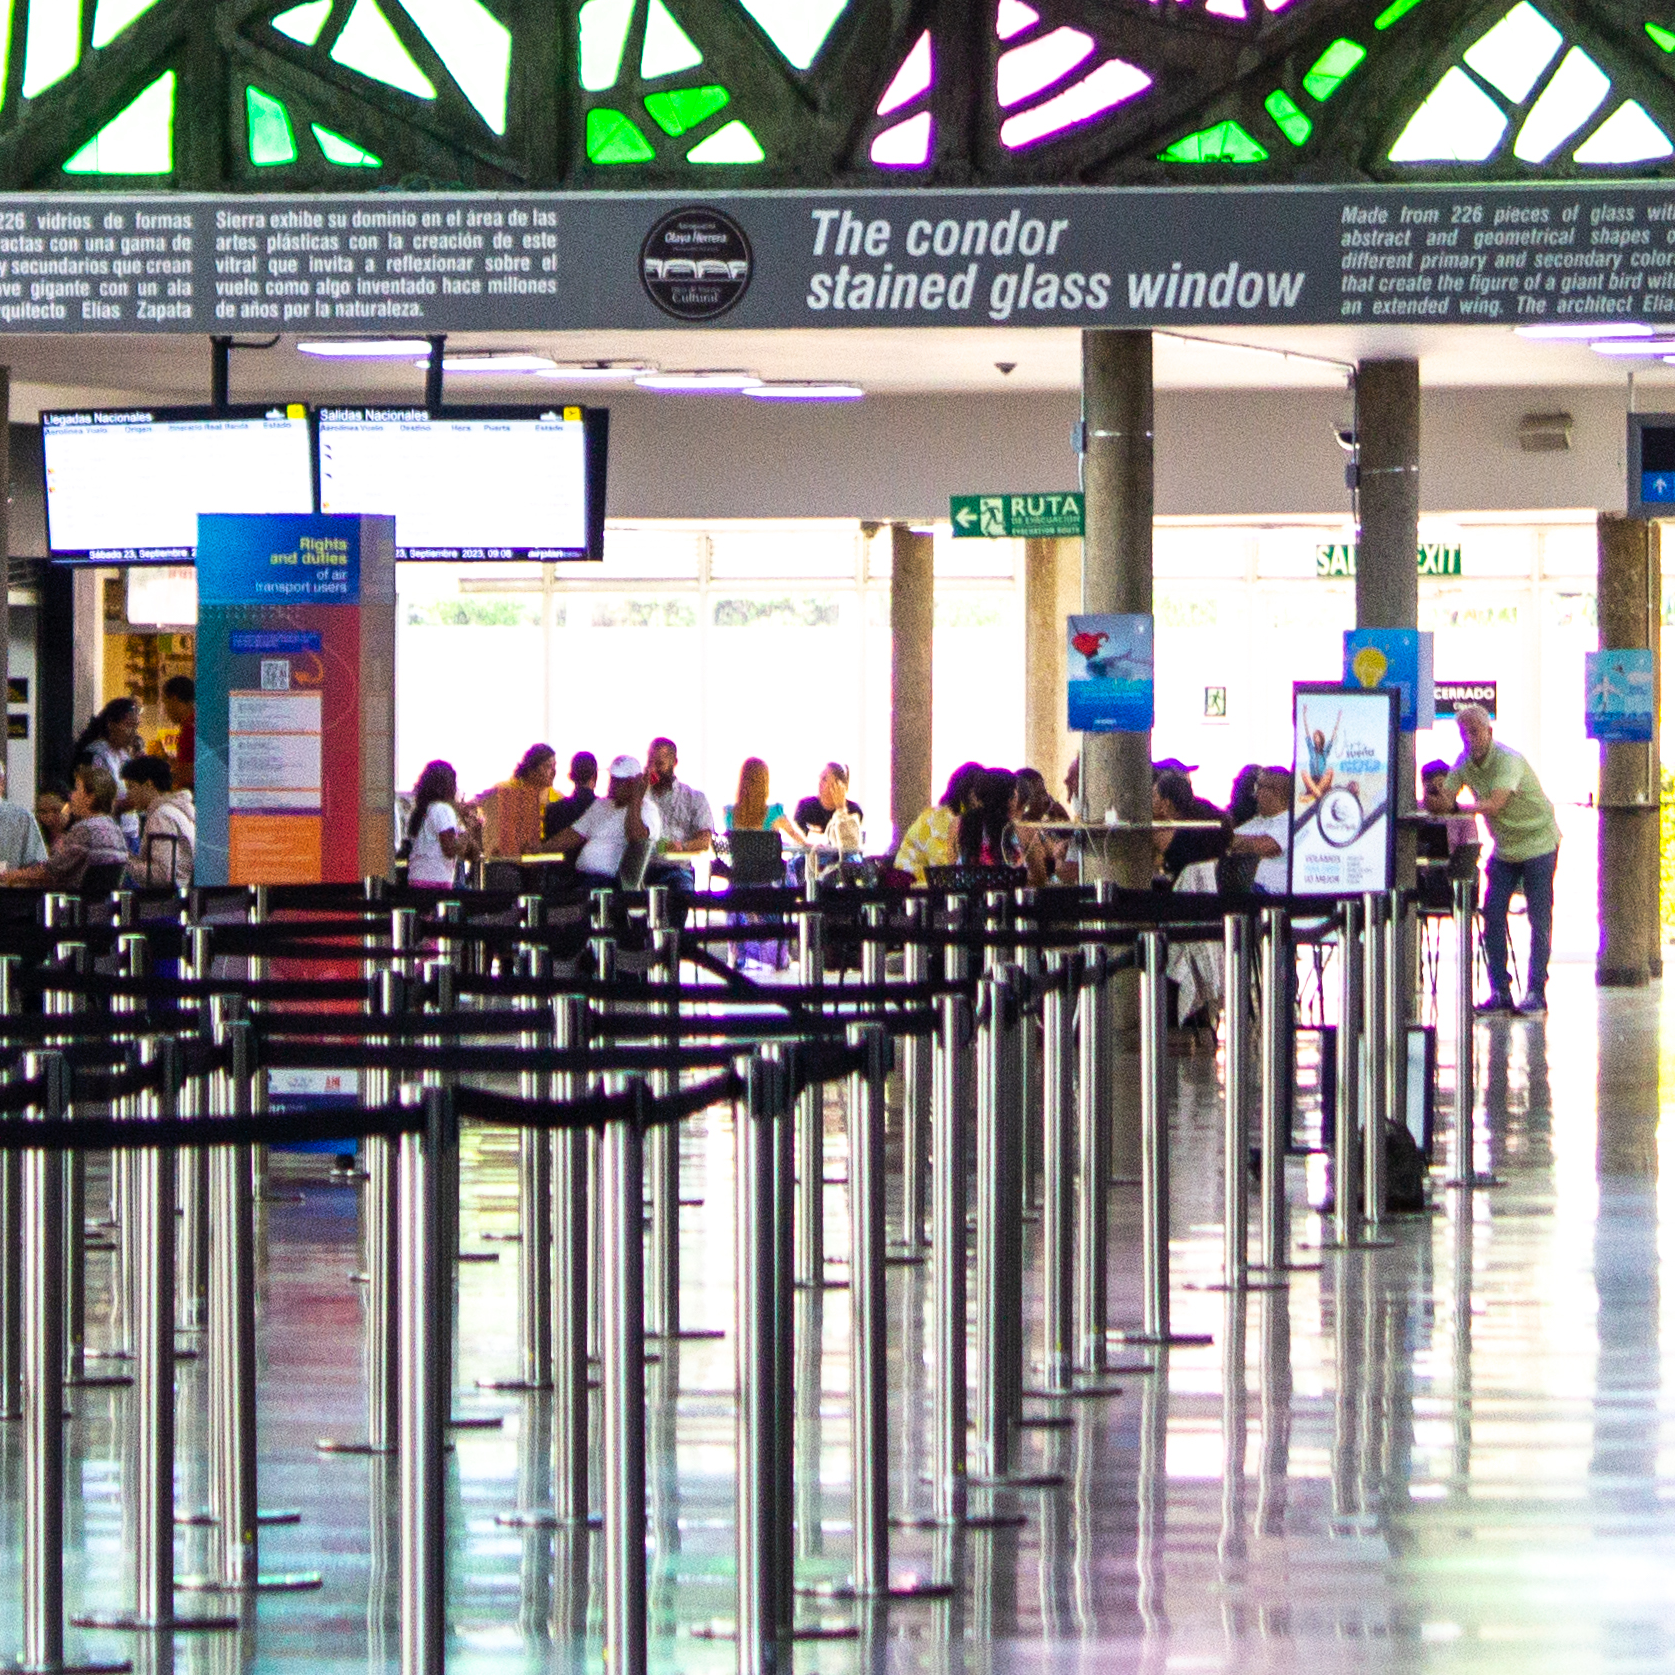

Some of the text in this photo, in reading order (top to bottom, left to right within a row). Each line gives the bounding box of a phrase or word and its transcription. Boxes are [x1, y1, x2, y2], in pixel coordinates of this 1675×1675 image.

[37, 212, 92, 229] vidrios
[103, 212, 124, 229] de
[135, 212, 193, 229] formas
[216, 210, 557, 228] Sierra exhibe su dominio en el área de las
[1340, 206, 1390, 224] Made
[1399, 206, 1441, 224] from
[1450, 206, 1484, 223] 226
[1493, 205, 1551, 228] pieces
[1560, 205, 1580, 223] of
[1589, 205, 1636, 227] glass
[811, 209, 1069, 257] The condor
[1340, 228, 1412, 246] abstract
[1425, 228, 1459, 245] and
[1472, 227, 1576, 250] geometrical
[1589, 227, 1652, 249] shapes
[49, 238, 79, 252] con
[85, 238, 115, 252] una
[120, 238, 166, 257] gama
[172, 235, 192, 252] de
[215, 233, 557, 256] artes plásticas con la creación de este
[11, 258, 109, 275] secundarios
[112, 260, 142, 280] que
[146, 260, 192, 275] crean
[215, 256, 558, 279] vitral que invita a reflexionar sobre el
[1340, 251, 1414, 269] different
[1420, 251, 1488, 273] primary
[1494, 251, 1528, 268] and
[1533, 250, 1623, 273] secondary
[30, 280, 90, 302] gigante
[99, 282, 129, 297] con
[137, 282, 158, 297] un
[167, 280, 193, 297] ala
[215, 278, 557, 301] vuelo como algo inventado hace millones
[807, 261, 1305, 320] stained glass window
[137, 302, 193, 324] Zapata
[215, 301, 424, 324] de años por la naturaleza.
[43, 411, 153, 426] Llegadas Nacionales
[320, 408, 429, 422] Salidas Nacionales
[1010, 496, 1080, 516] RUTA
[139, 548, 187, 561] Septiembre
[300, 536, 348, 553] Rights
[410, 548, 458, 561] Septiembre
[270, 552, 348, 566] and duties
[316, 569, 329, 580] of
[256, 581, 348, 595] transport users
[1433, 686, 1495, 700] CERRADO
